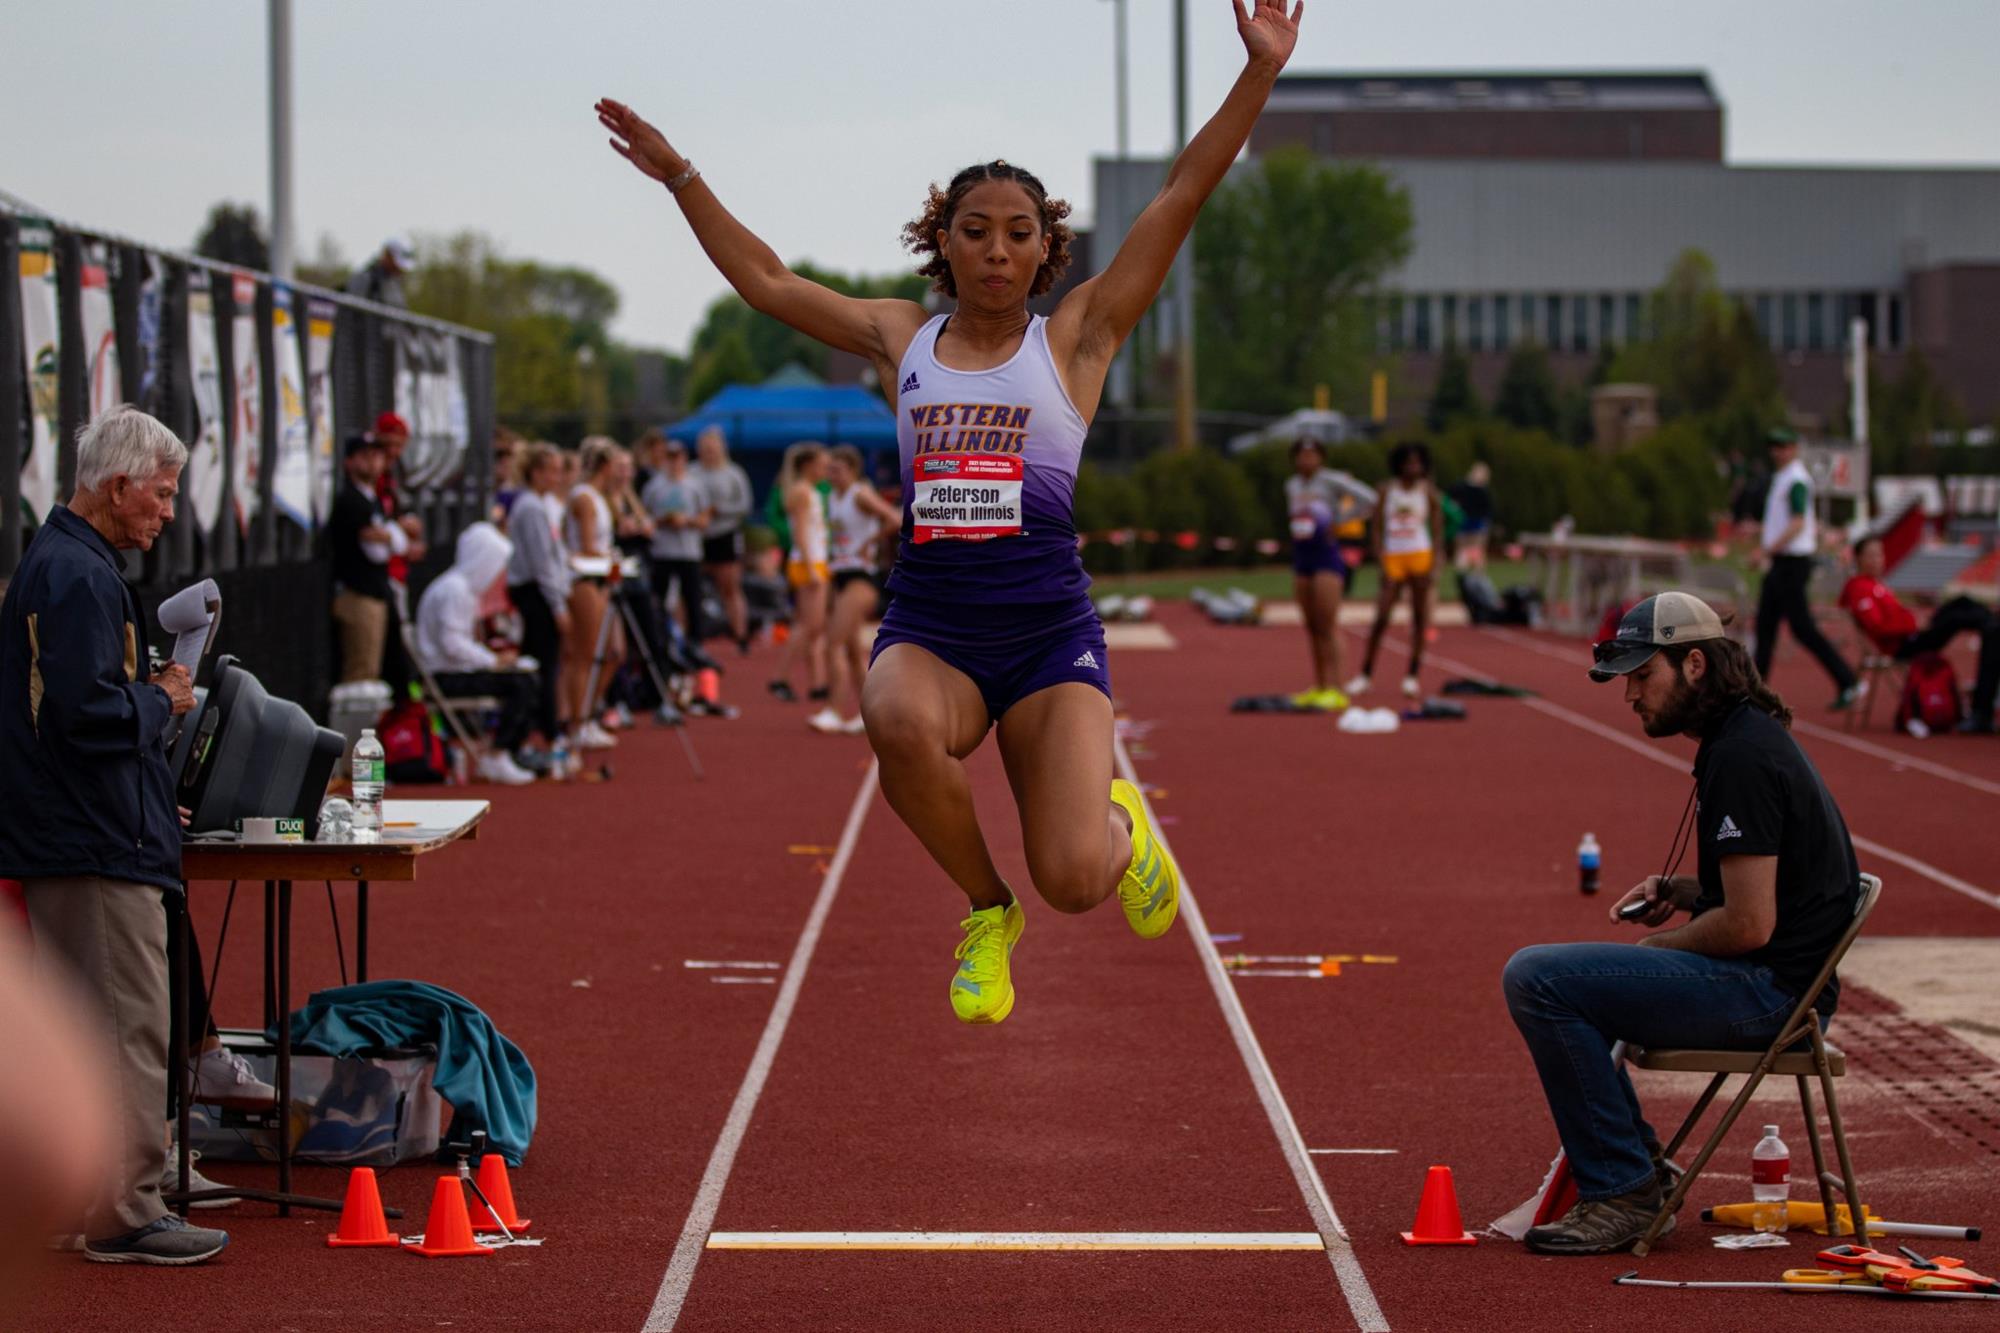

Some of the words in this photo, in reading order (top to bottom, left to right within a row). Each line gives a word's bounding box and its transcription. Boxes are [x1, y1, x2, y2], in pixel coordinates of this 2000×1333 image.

[909, 403, 1032, 429] WESTERN
[914, 429, 1029, 455] ILLINOIS
[930, 485, 1000, 504] Peterson
[917, 506, 967, 521] Western
[971, 505, 1014, 521] Illinois
[1716, 830, 1742, 841] adidas
